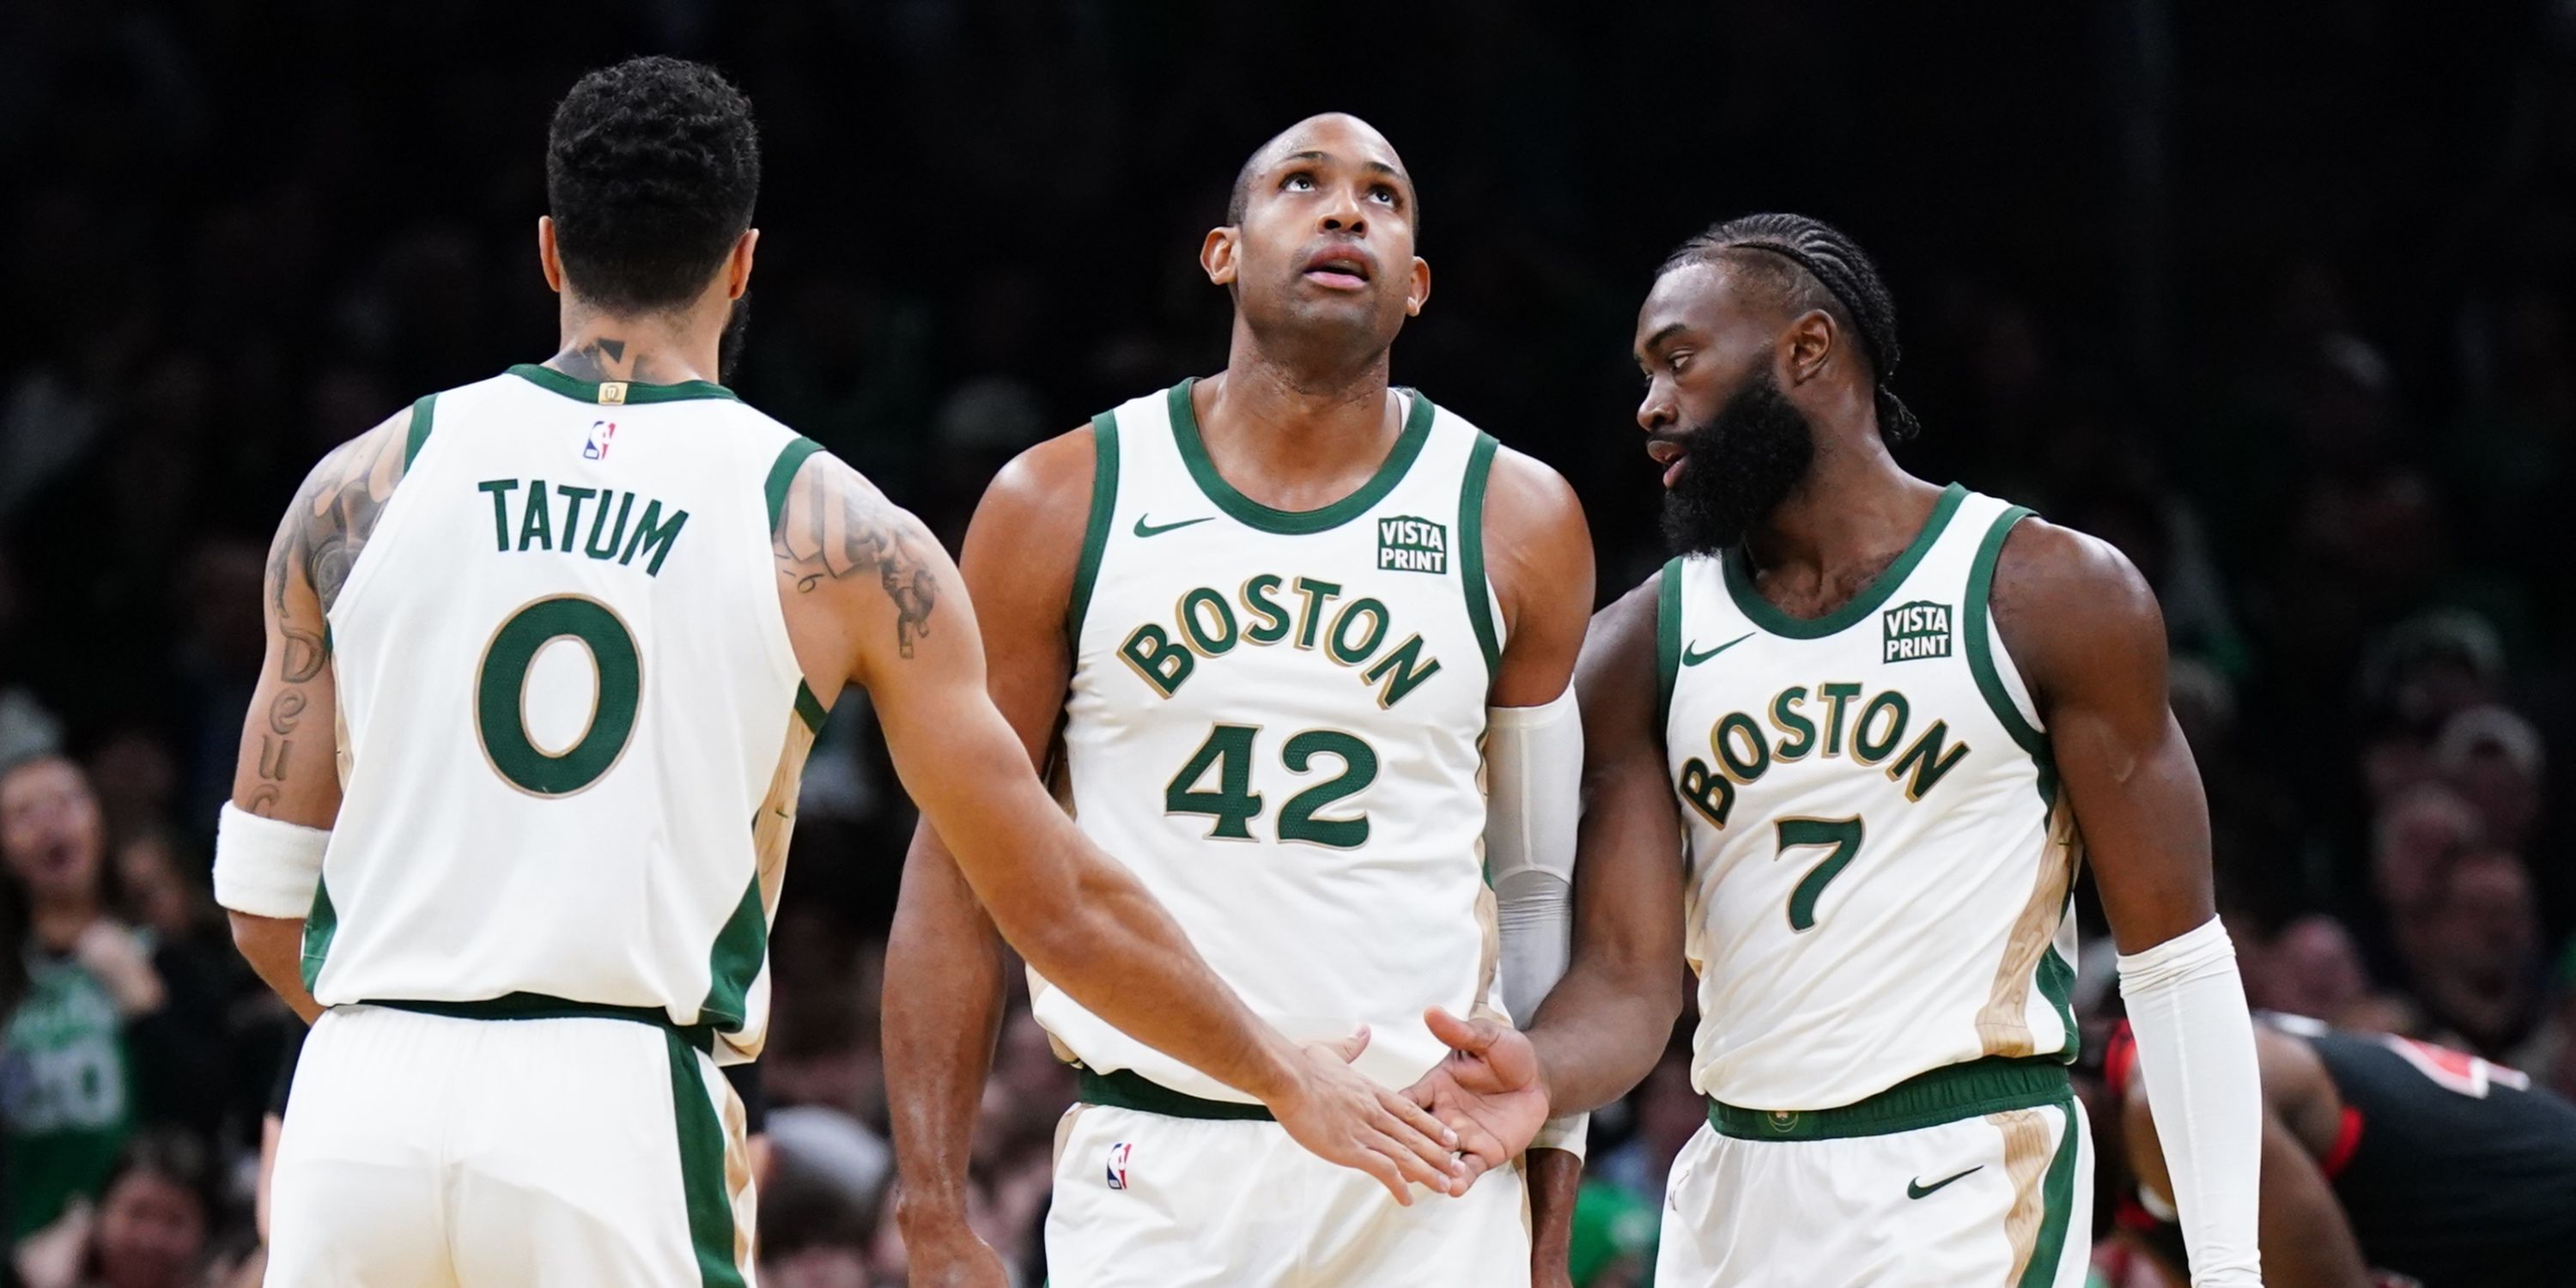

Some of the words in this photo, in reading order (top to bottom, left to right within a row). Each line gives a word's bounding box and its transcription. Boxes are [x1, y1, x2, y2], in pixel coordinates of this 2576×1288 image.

[478, 478, 690, 578] TATUM
[1381, 520, 1444, 551] VISTA
[1381, 548, 1444, 572] PRINT
[1116, 574, 1443, 711] BOSTON
[1886, 606, 1949, 637] VISTA
[1886, 635, 1949, 660] PRINT
[472, 592, 645, 800] 0
[1163, 721, 1382, 851] 42
[1679, 682, 1971, 831] BOSTON
[1773, 812, 1866, 935] 7
